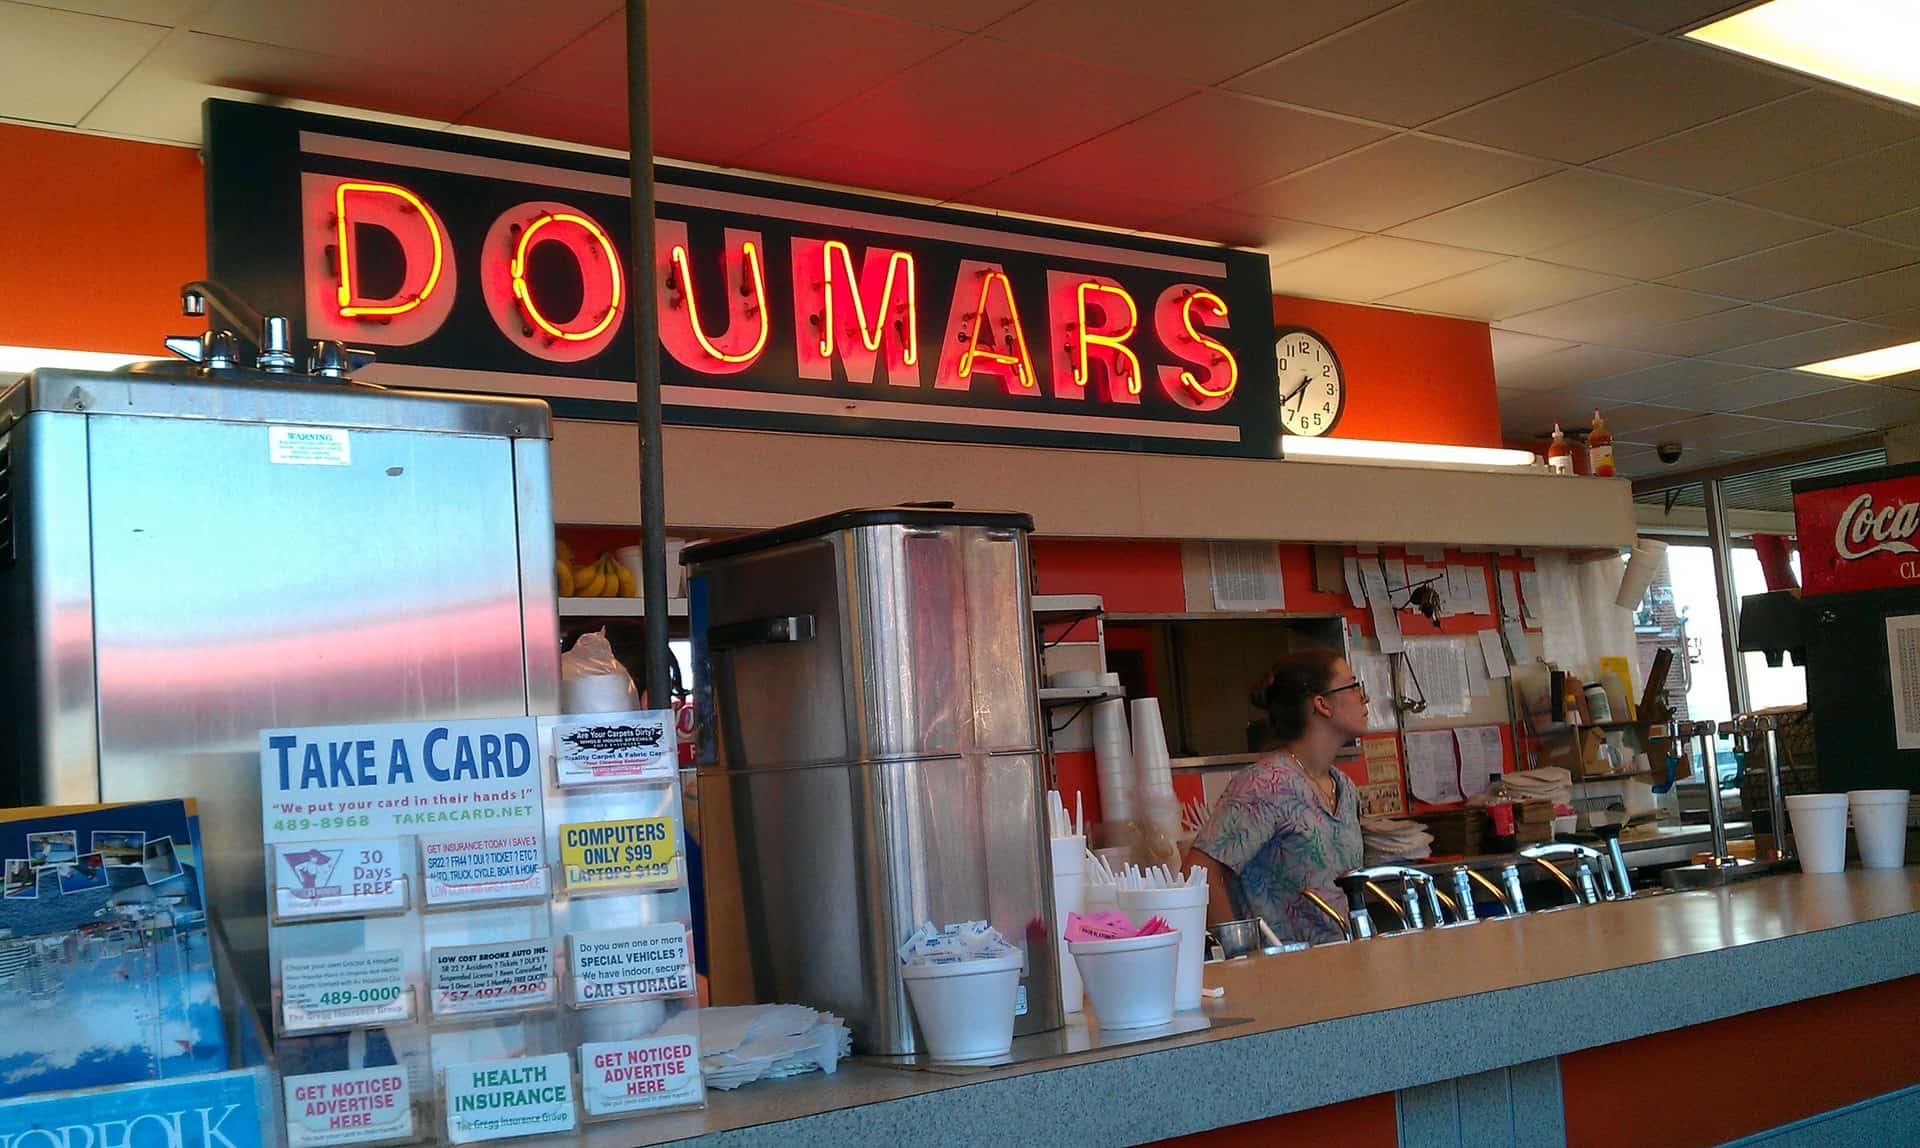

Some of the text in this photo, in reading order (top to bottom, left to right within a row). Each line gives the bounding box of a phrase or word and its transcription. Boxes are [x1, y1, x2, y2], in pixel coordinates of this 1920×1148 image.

[302, 172, 1241, 411] DOUMARS
[1287, 344, 1295, 357] 11
[1299, 341, 1310, 354] 12
[1279, 358, 1287, 370] 0
[1322, 365, 1330, 377] 2
[1326, 383, 1334, 396] 3
[1287, 408, 1295, 421] 7
[1323, 401, 1330, 414] 4
[1301, 416, 1309, 429] 6
[1313, 413, 1321, 425] 5
[287, 432, 333, 441] WARNING
[576, 728, 655, 740] Are Your Carpets Dirty?
[269, 727, 531, 791] TAKE A CARD
[591, 753, 616, 761] Carpet
[308, 802, 334, 815] put
[338, 801, 373, 813] your
[378, 796, 409, 808] card
[414, 795, 428, 806] in
[433, 794, 468, 805] their
[473, 790, 517, 802] hands
[274, 815, 369, 831] 489-8968
[391, 806, 533, 825] TAKEACARD.NET
[567, 823, 666, 848] COMPUTERS
[427, 844, 441, 854] GET
[443, 841, 483, 853] INSURANCE
[484, 839, 507, 850] TODAY
[512, 837, 531, 847] SAVE
[360, 850, 383, 864] 30
[428, 858, 445, 869] SR22
[490, 851, 514, 863] TICKET
[584, 844, 652, 865] ONLY $99
[353, 866, 392, 881] Days
[497, 867, 514, 877] BOAT
[569, 865, 631, 883] LAPTOPS
[353, 881, 393, 896] FREE
[580, 936, 683, 953] Do you own one or more
[438, 956, 456, 964] LOW
[458, 954, 477, 962] COST
[512, 948, 532, 957] AUTO
[581, 948, 684, 968] SPECIAL VEHICLES ?
[582, 971, 596, 980] We
[598, 969, 620, 980] have
[655, 964, 686, 974] secure
[320, 985, 401, 1005] 489-0000
[583, 975, 688, 999] CAR STORAGE
[595, 1044, 692, 1068] GET NOTICED
[473, 1066, 547, 1088] HEALTH
[604, 1060, 686, 1083] ADVERTISE
[295, 1077, 402, 1101] GET NOTICED
[627, 1079, 666, 1095] HERE
[305, 1094, 395, 1117] ADVERTISE
[455, 1085, 567, 1112] INSURANCE
[330, 1113, 372, 1129] HERE
[456, 1112, 568, 1131] The Gregg Insurance Group
